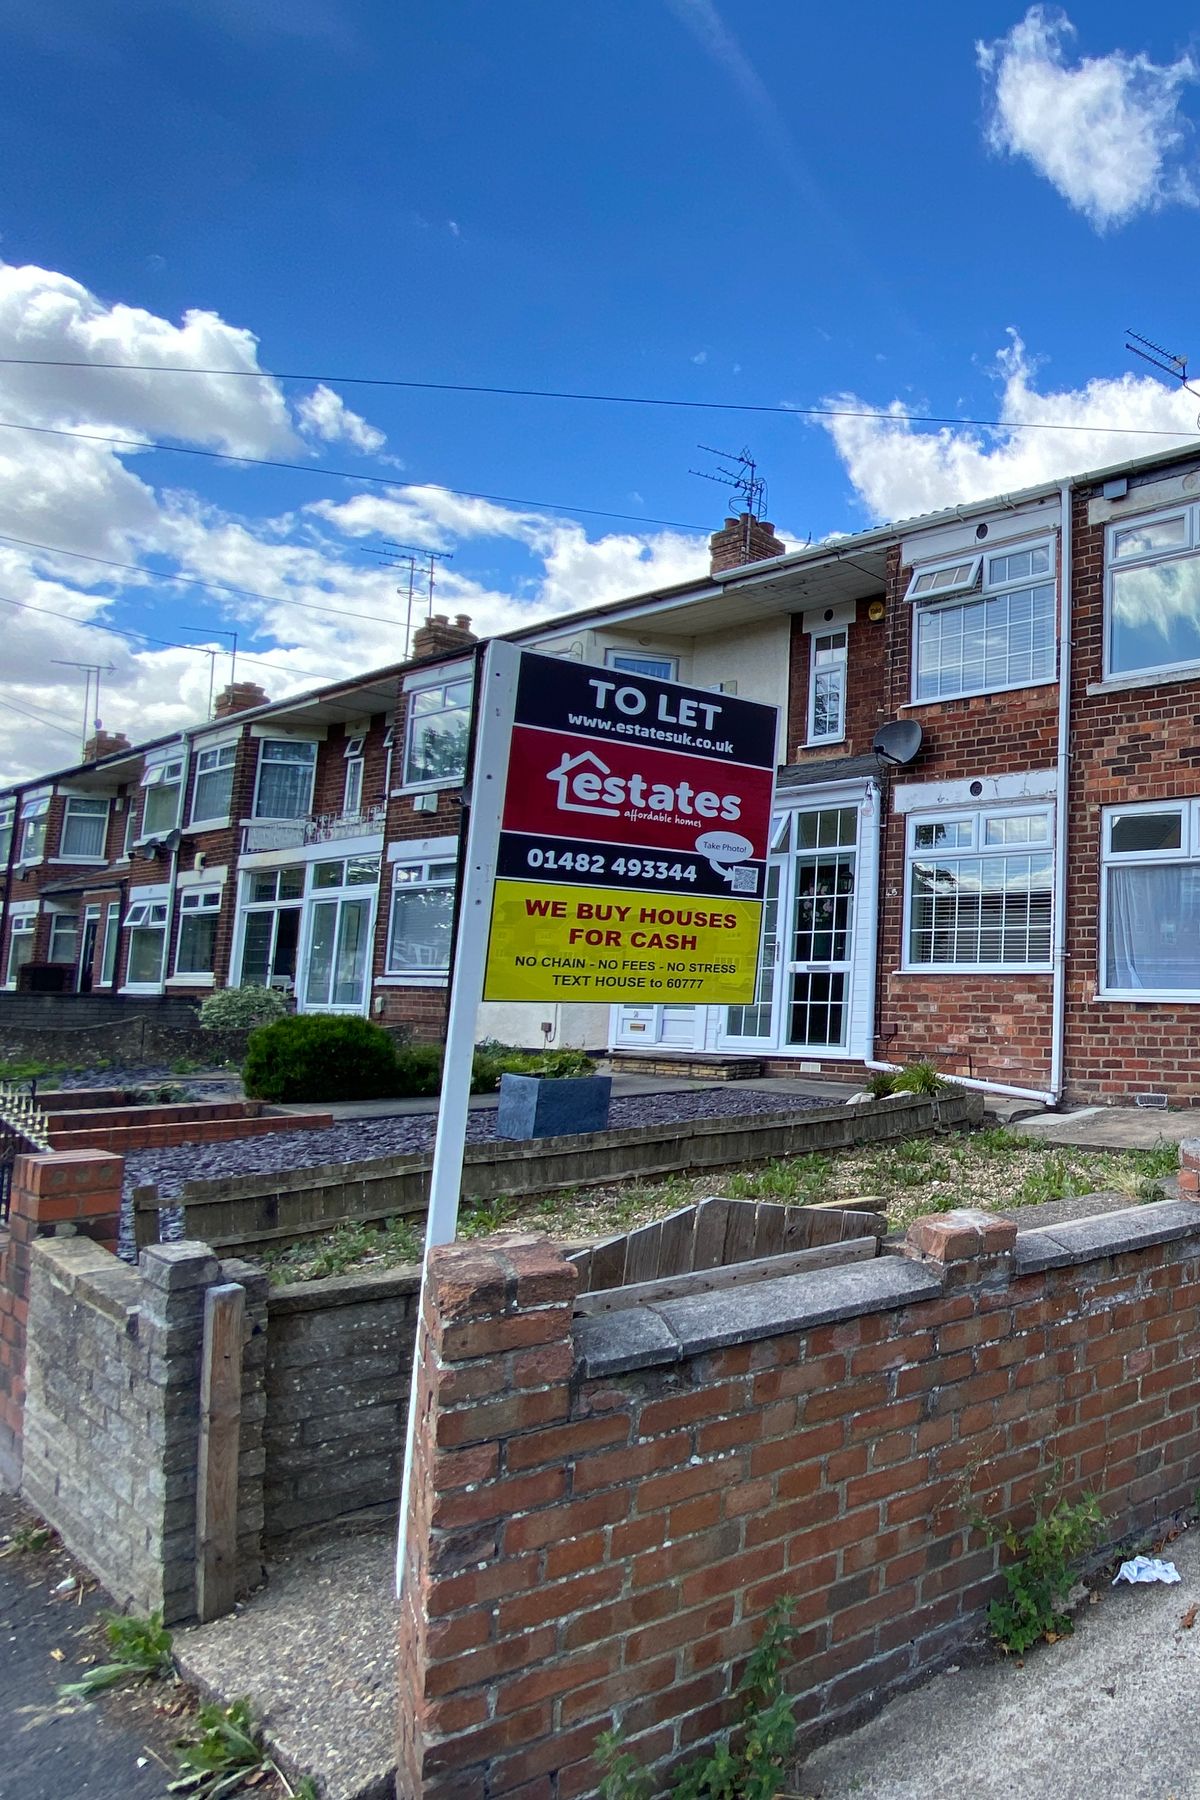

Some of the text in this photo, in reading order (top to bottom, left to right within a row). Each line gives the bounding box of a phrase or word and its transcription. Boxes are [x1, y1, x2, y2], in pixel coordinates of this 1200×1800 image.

[588, 678, 722, 731] TO LET
[568, 713, 734, 754] www.estatesuk.co.uk
[572, 772, 742, 821] estates
[623, 809, 702, 828] affordable homes
[703, 841, 748, 854] Take Photo!
[527, 849, 697, 882] 01482 493344
[525, 899, 737, 929] WE BUY HOUSES
[569, 928, 697, 950] FOR CASH
[515, 956, 537, 967] NO
[541, 957, 586, 969] CHAIN
[598, 959, 618, 970] NO
[622, 961, 656, 971] FEES
[667, 962, 685, 973] NO
[688, 963, 737, 974] STRESS
[552, 975, 704, 989] TEXT HOUSE to 60777
